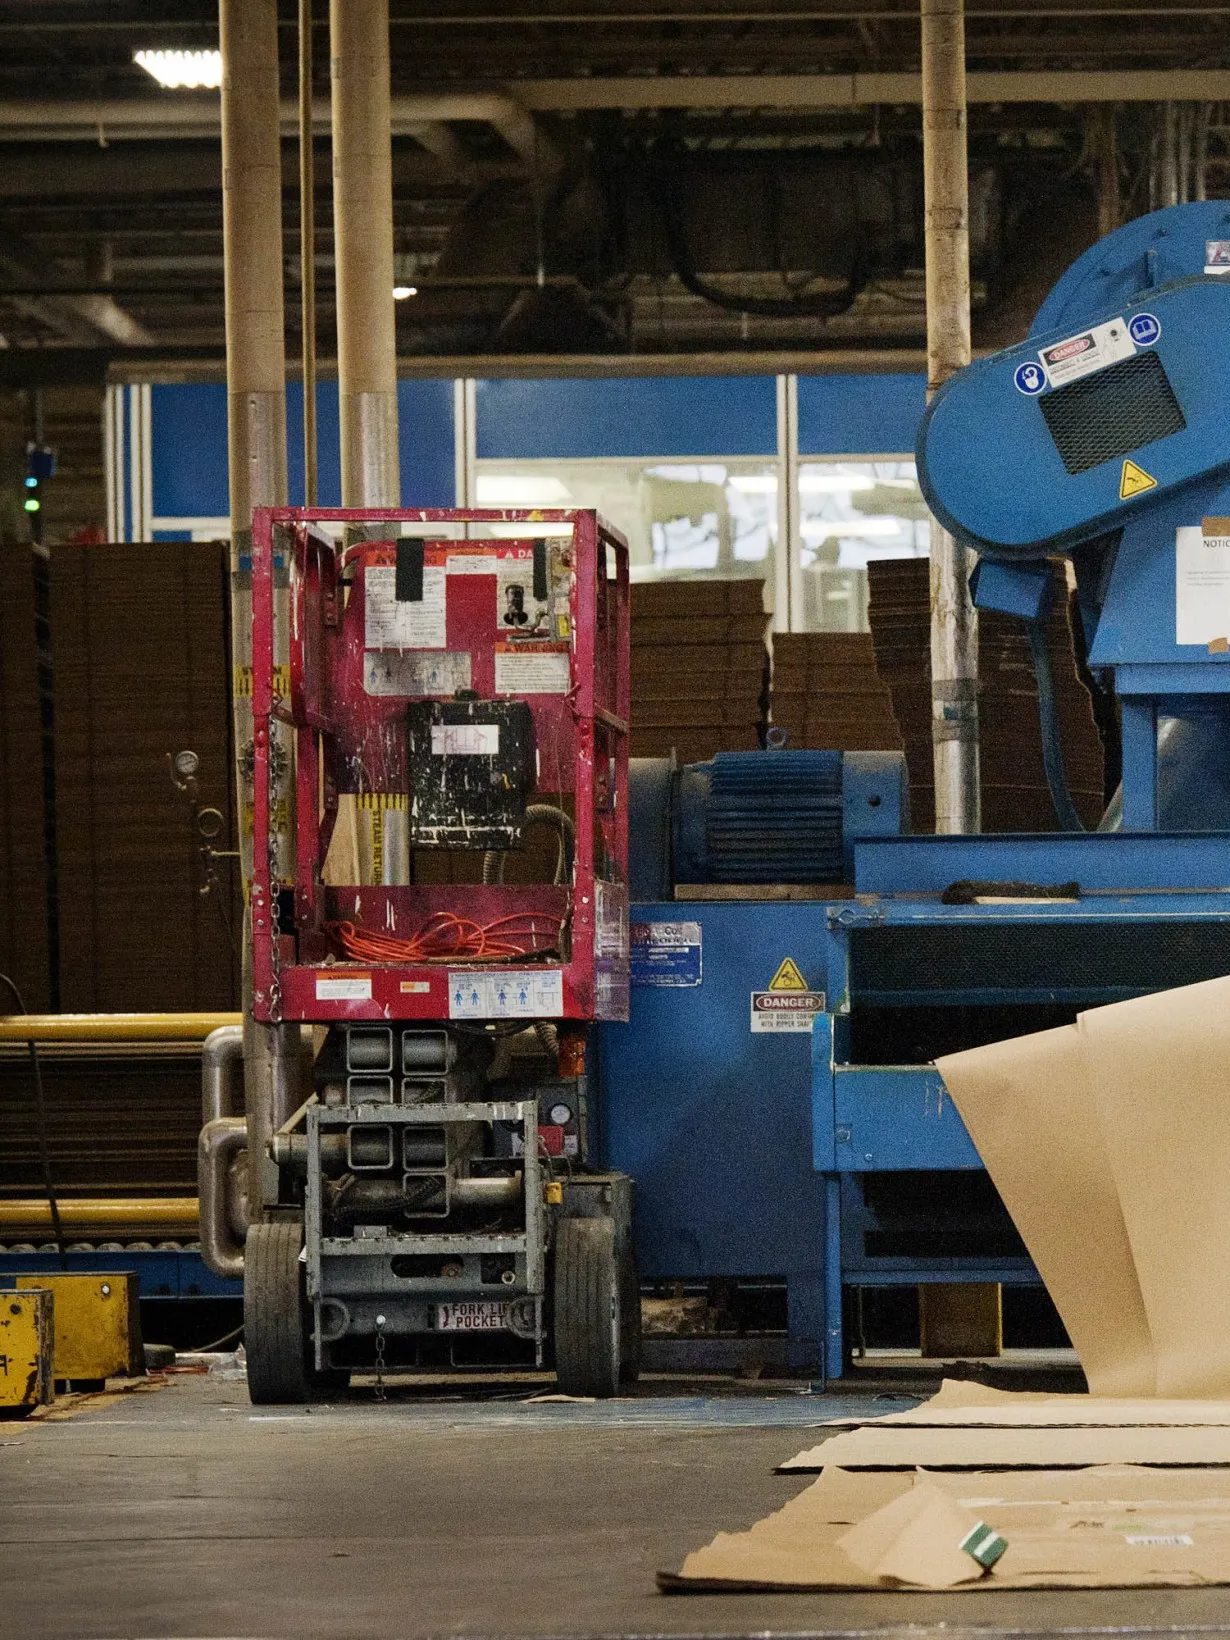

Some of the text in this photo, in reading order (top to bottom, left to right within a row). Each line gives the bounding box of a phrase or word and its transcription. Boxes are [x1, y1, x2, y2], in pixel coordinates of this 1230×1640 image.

[1055, 340, 1085, 358] DANGER
[372, 811, 382, 843] STEAM
[763, 997, 814, 1007] DANGER
[452, 1302, 511, 1315] FORK LIF
[456, 1315, 505, 1328] POCKET
